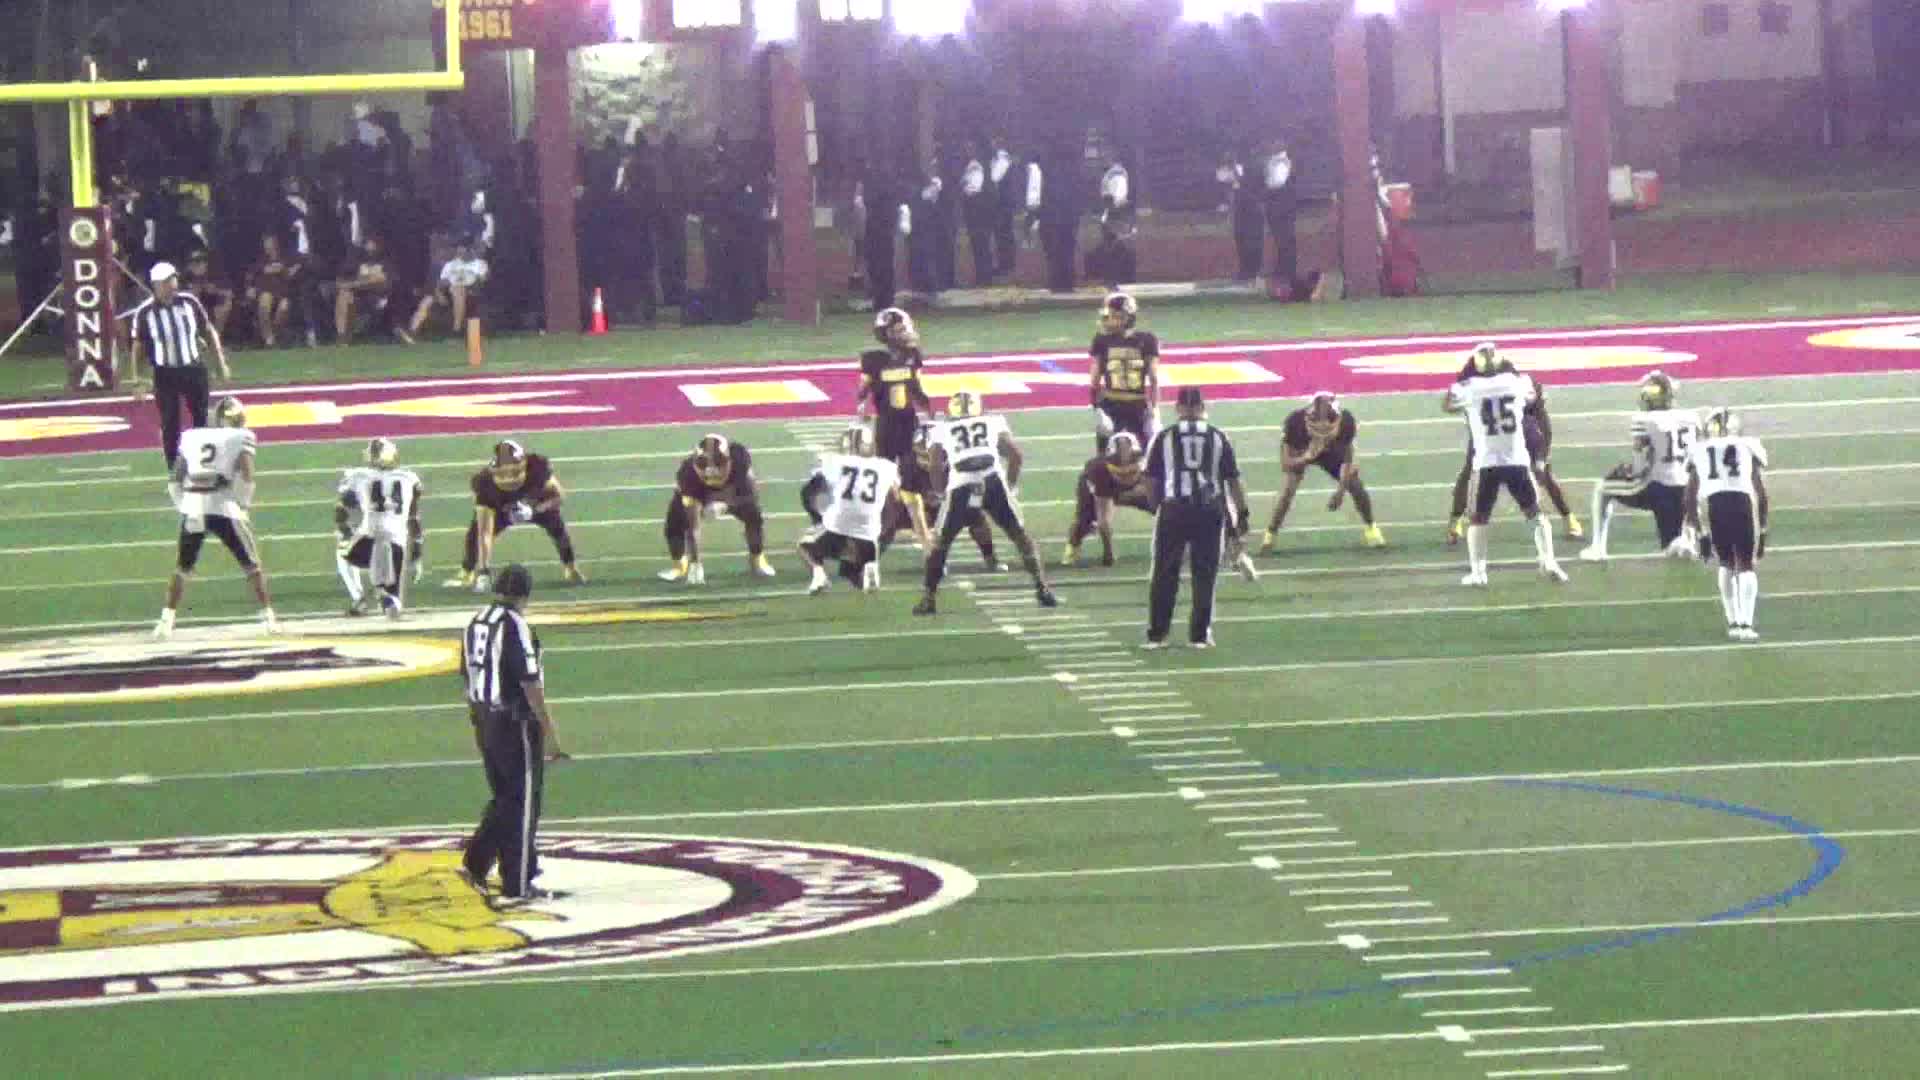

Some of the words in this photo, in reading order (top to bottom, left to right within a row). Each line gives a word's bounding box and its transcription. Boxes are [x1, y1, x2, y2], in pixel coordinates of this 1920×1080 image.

[73, 258, 104, 388] DONNA
[1480, 394, 1517, 435] 45
[200, 442, 217, 467] 2
[950, 421, 989, 451] 32
[1706, 443, 1741, 480] 14
[369, 479, 404, 515] 44
[841, 465, 879, 504] 73
